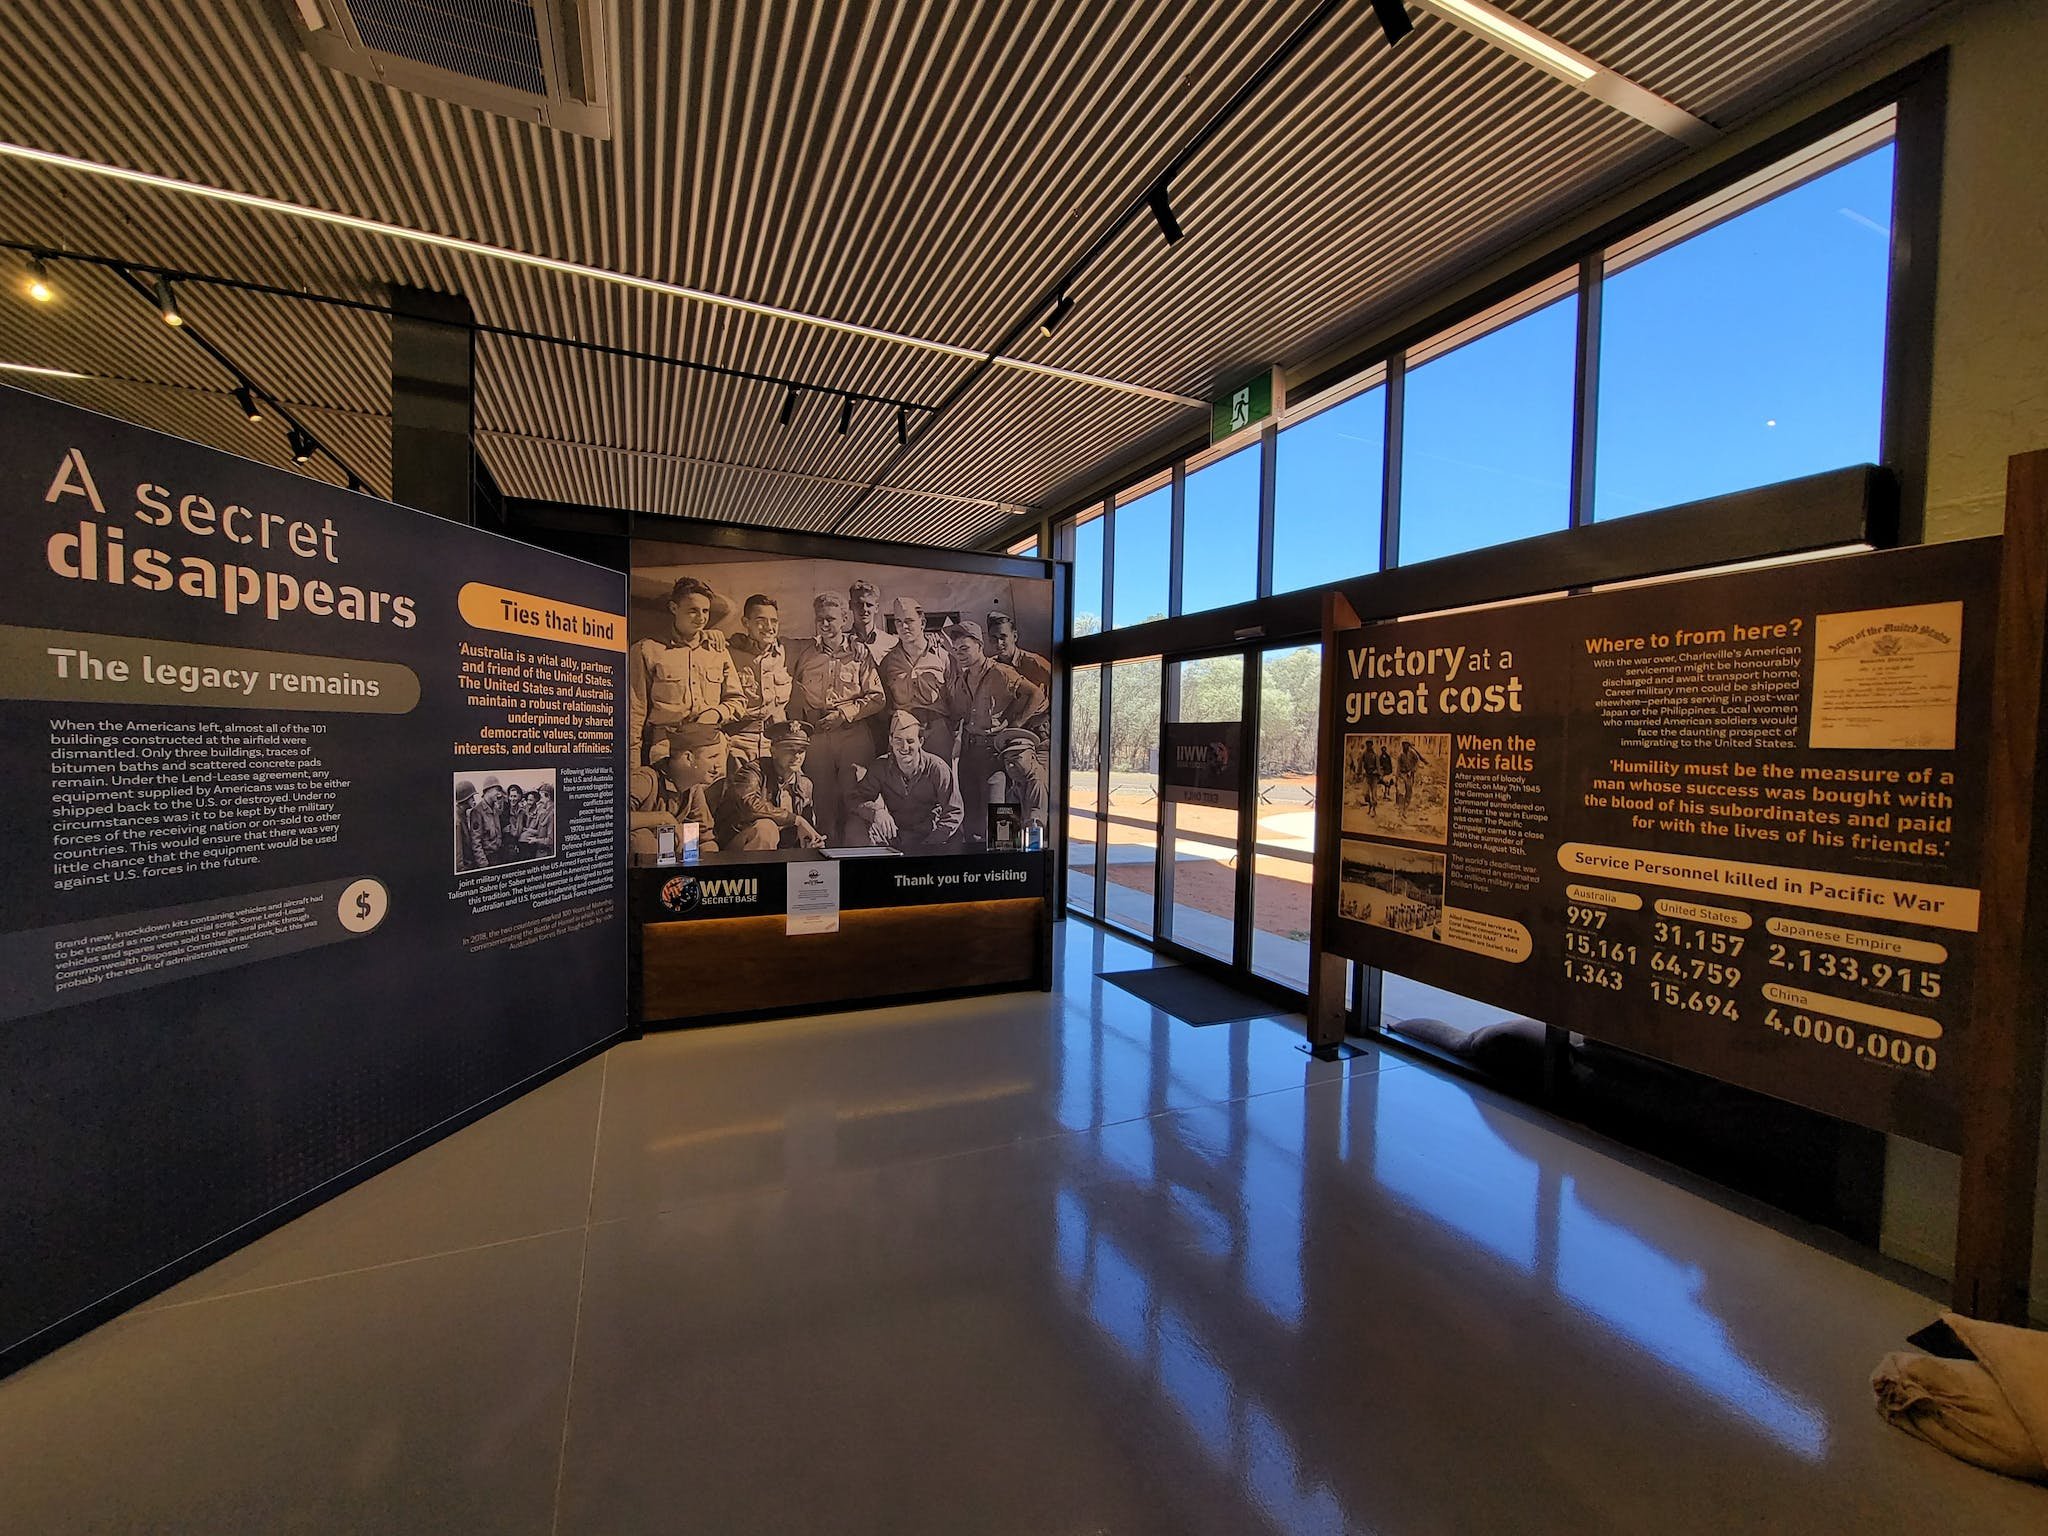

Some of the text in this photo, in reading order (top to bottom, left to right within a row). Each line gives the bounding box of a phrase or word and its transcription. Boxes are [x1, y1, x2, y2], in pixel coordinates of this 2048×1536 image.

[45, 447, 340, 564] A secret
[47, 520, 418, 629] disappears
[500, 598, 614, 640] Ties that bind
[1585, 618, 1803, 654] Where to from here?
[516, 650, 526, 662] is
[528, 653, 535, 664] a
[537, 654, 559, 667] vital
[560, 656, 579, 671] ally,
[581, 660, 614, 675] partner,
[1347, 645, 1513, 682] Victory at a
[1593, 660, 1614, 668] With
[1616, 658, 1632, 666] the
[1653, 656, 1677, 664] over,
[1678, 649, 1742, 662] Charleville's
[1743, 645, 1801, 658] American
[47, 647, 381, 698] The legacy remains
[462, 661, 614, 687] and friend of the United States.
[458, 675, 614, 701] The United States and Australia
[1345, 676, 1523, 724] great cost
[467, 694, 614, 717] maintain a robust relationship
[50, 719, 327, 734] When the Americans left, almost all of the 101
[508, 712, 614, 728] underpinned by shared
[50, 733, 307, 747] buildings constructed at the airfield were
[480, 726, 614, 741] democratic values, common
[1456, 735, 1537, 752] When the
[1620, 737, 1797, 749] immigrating to the United States.
[454, 741, 509, 756] interests,
[511, 742, 531, 755] and
[533, 742, 571, 755] cultural
[1455, 753, 1534, 772] Axis falls
[1684, 762, 1729, 776] must
[1734, 762, 1757, 778] be
[1762, 763, 1795, 779] the
[1800, 766, 1900, 783] measure
[1907, 768, 1933, 785] of
[1939, 771, 1954, 785] a
[1455, 772, 1471, 780] After
[1473, 774, 1491, 782] years
[1500, 775, 1526, 784] bloody
[1593, 778, 1953, 809] man whose success was bought with
[1584, 794, 1952, 834] the blood of his subordinates and paid
[1632, 814, 1656, 829] for
[1659, 817, 1696, 833] with
[1700, 821, 1729, 836] the
[1734, 823, 1780, 841] lives
[1785, 829, 1807, 844] of
[1812, 829, 1845, 847] his
[699, 878, 758, 898] WWII
[894, 869, 1028, 887] Thank you for visiting
[1575, 851, 1945, 913] Service Personnel killed in Pacific War
[701, 894, 758, 905] SECRET BASE
[1573, 888, 1617, 904] Australia
[55, 893, 324, 950] Brand new, knockdown kits containing vehicles and aircraft had
[1567, 905, 1608, 929] 997
[1660, 902, 1738, 924] United States
[1565, 932, 1637, 965] 15,161
[1654, 921, 1745, 957] 31,157
[1773, 921, 1902, 953] Japanese Empire
[1563, 959, 1623, 991] 1,343
[1650, 951, 1742, 988] 64,759
[1768, 943, 1942, 999] 2,133,915
[1650, 981, 1739, 1022] 15,694
[1769, 986, 1808, 1006] China
[1764, 1008, 1938, 1071] 4,000,000
